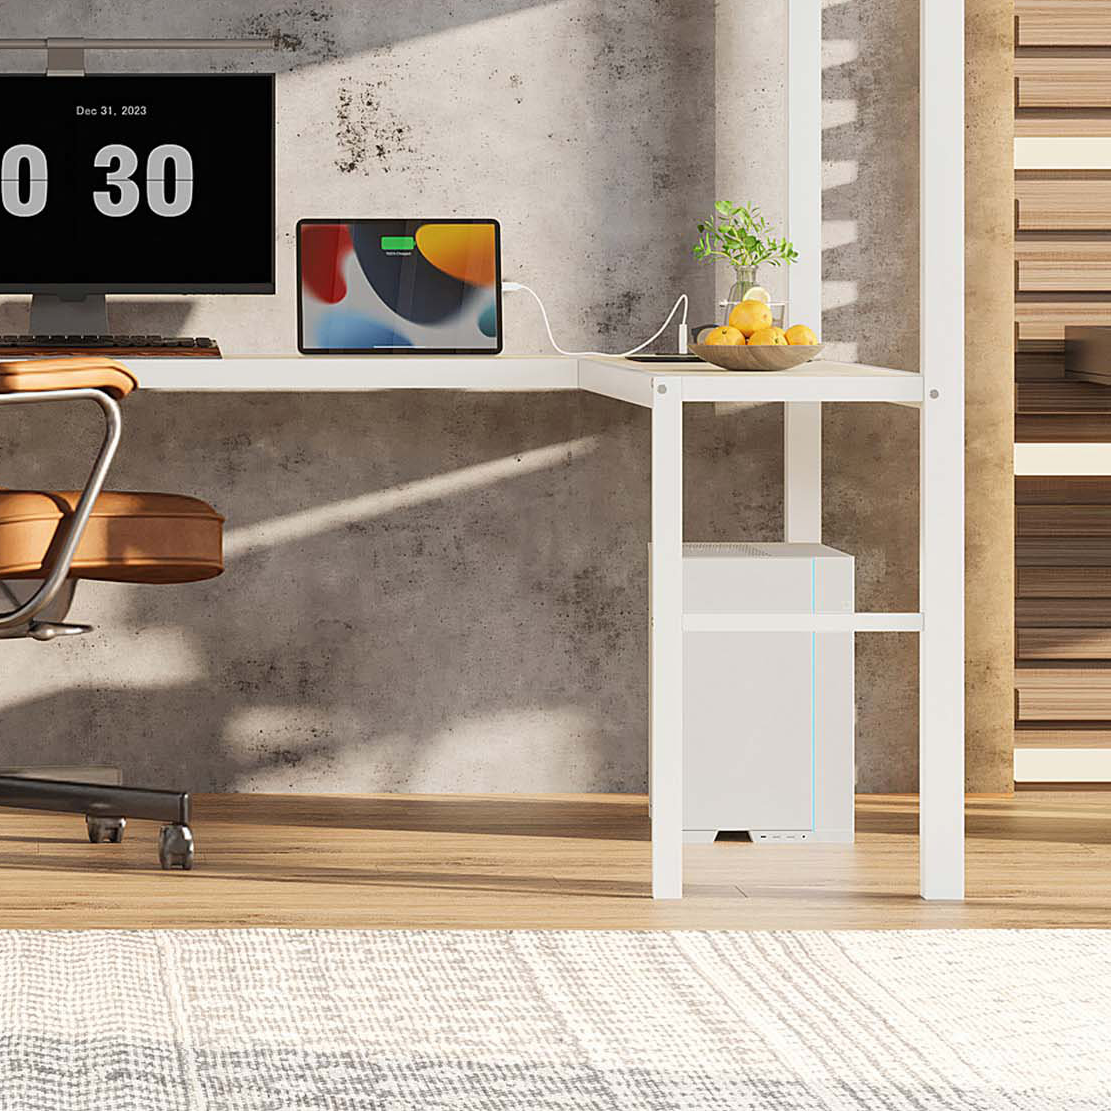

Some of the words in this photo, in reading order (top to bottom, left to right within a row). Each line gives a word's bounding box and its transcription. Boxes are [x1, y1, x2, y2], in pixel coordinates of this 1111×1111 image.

[76, 105, 98, 116] Dec
[100, 105, 117, 117] 31,
[121, 105, 147, 116] 2023
[92, 143, 194, 218] 30
